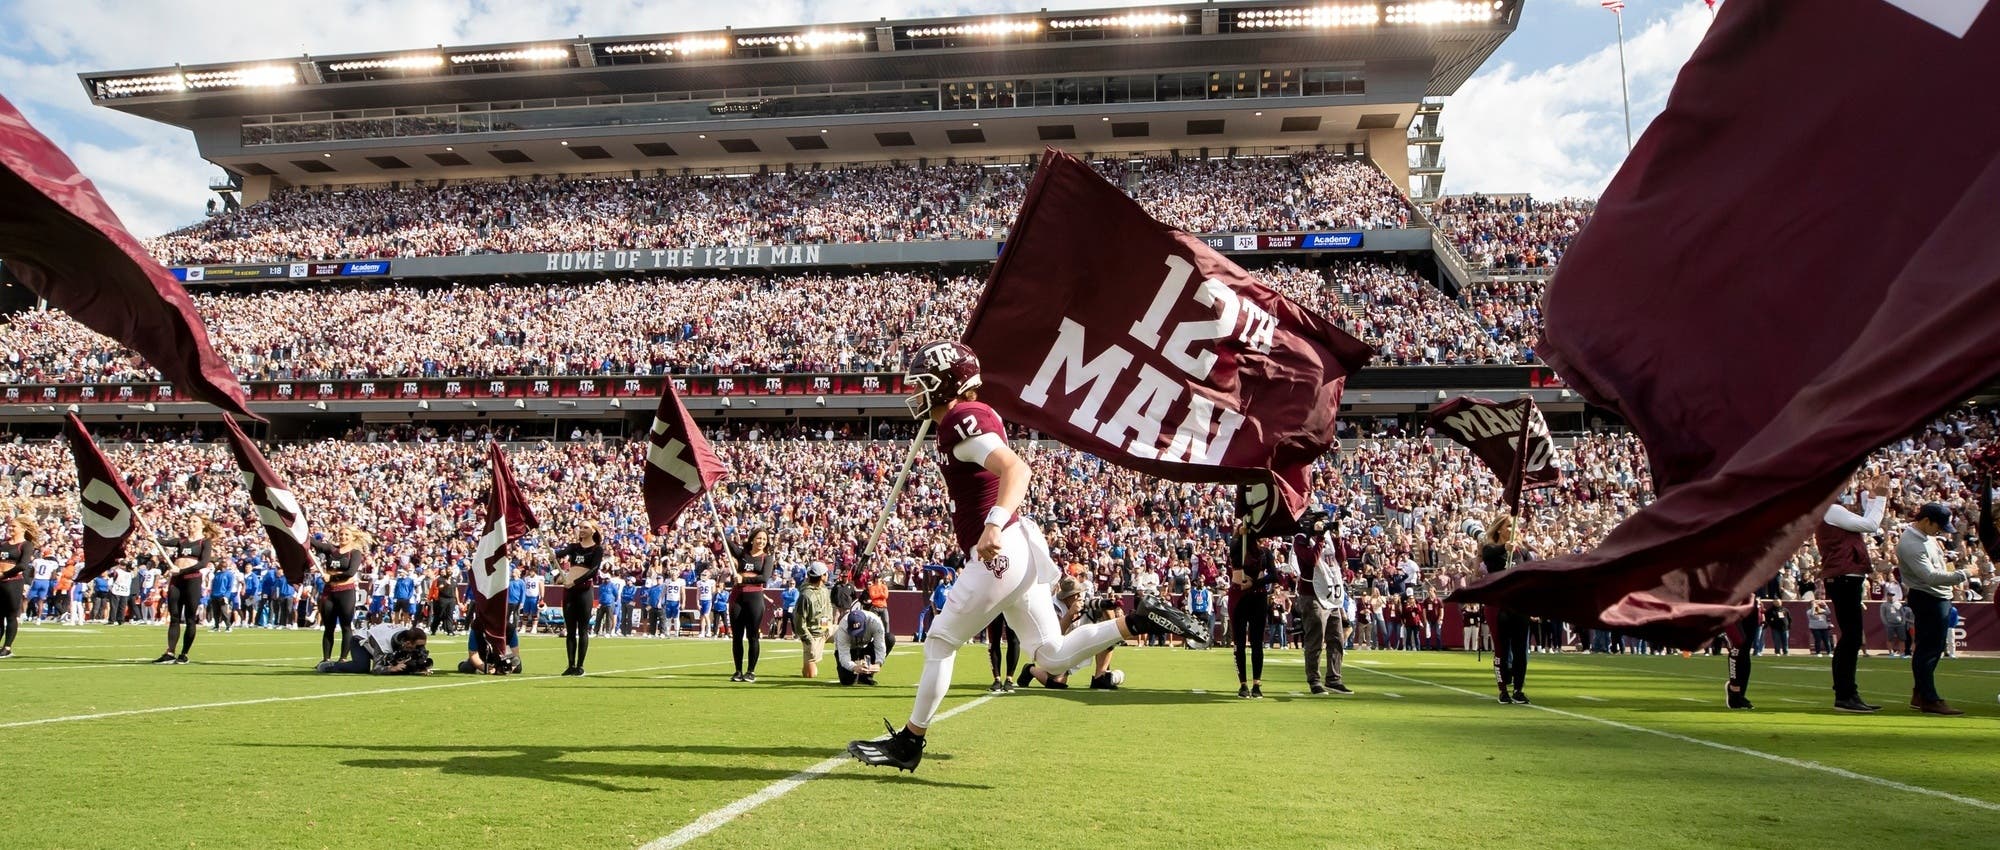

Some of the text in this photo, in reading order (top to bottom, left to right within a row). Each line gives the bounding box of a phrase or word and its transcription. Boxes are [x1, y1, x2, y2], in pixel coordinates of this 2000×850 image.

[1207, 239, 1223, 247] 1:18
[1313, 236, 1351, 245] Academy
[546, 245, 820, 271] HOME OF THE 12TH MAN
[270, 267, 282, 275] 1:18
[351, 264, 380, 272] Academy
[1019, 316, 1246, 466] MAN
[954, 414, 982, 440] 12
[668, 585, 679, 593] 29
[700, 585, 709, 594] 26
[1872, 582, 1881, 594] 12
[1148, 611, 1185, 635] ADIZERO
